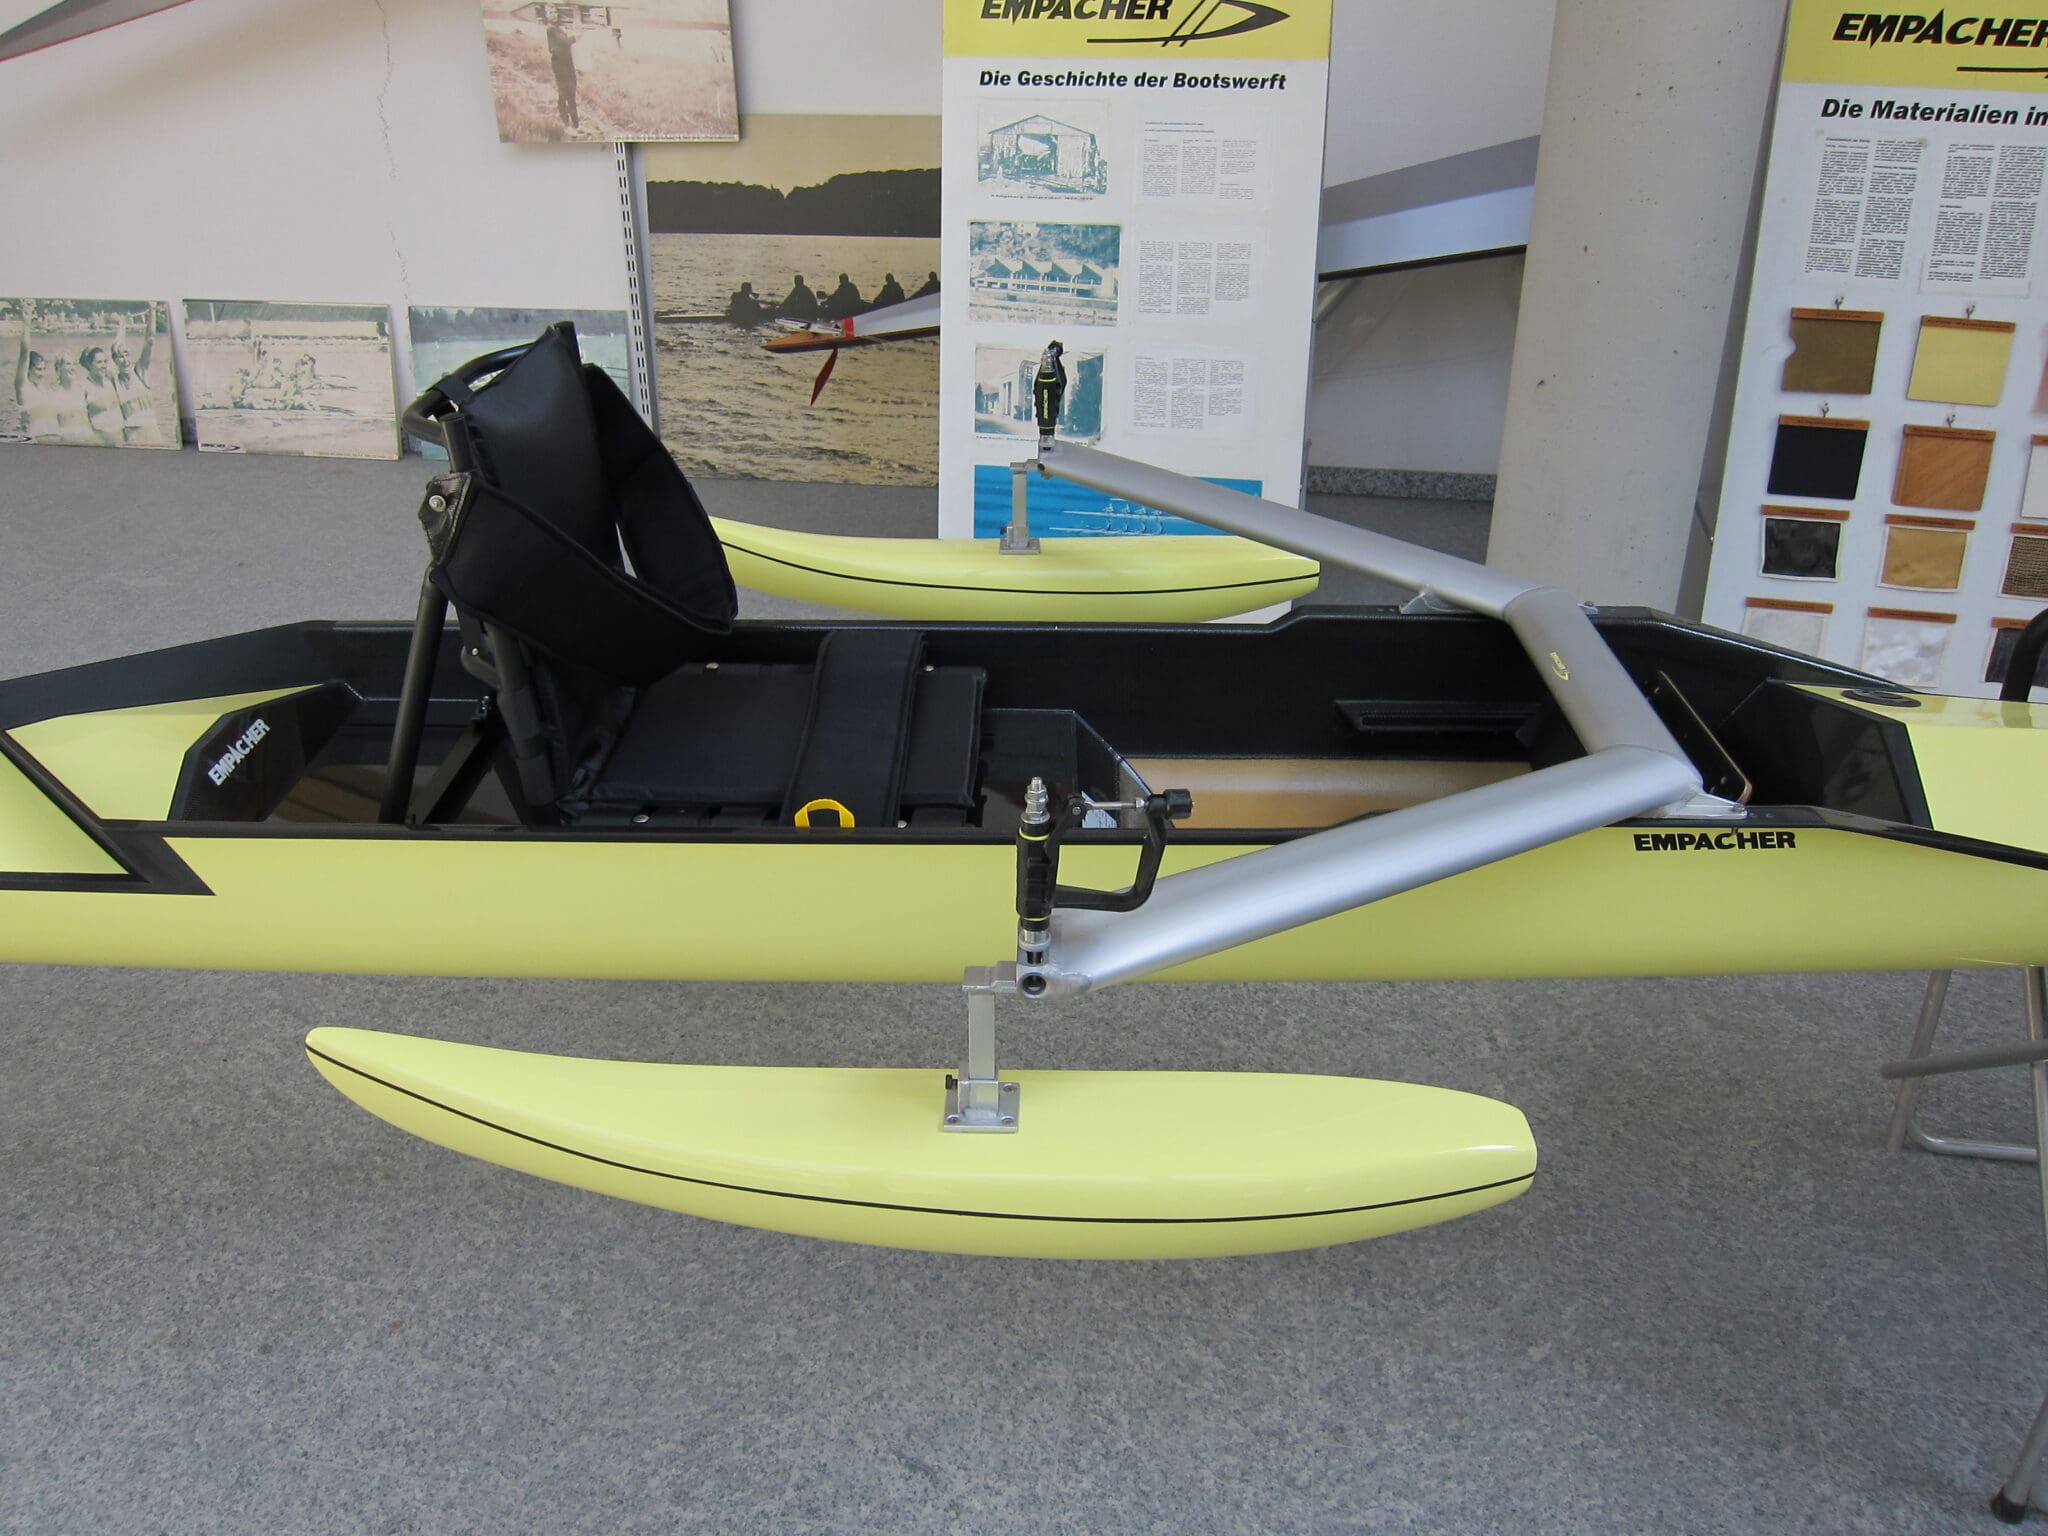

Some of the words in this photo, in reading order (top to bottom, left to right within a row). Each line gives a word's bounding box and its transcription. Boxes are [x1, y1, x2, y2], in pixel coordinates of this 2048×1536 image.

[980, 0, 1173, 25] EMPACHER
[979, 70, 1012, 87] Die
[1017, 70, 1128, 88] Geschichte
[1134, 71, 1168, 88] der
[1173, 72, 1287, 90] Bootswerft
[1821, 98, 1863, 119] Die
[1870, 99, 2019, 125] Materialien
[207, 718, 271, 786] EMPACHER
[1633, 831, 1797, 851] EMPACHER
